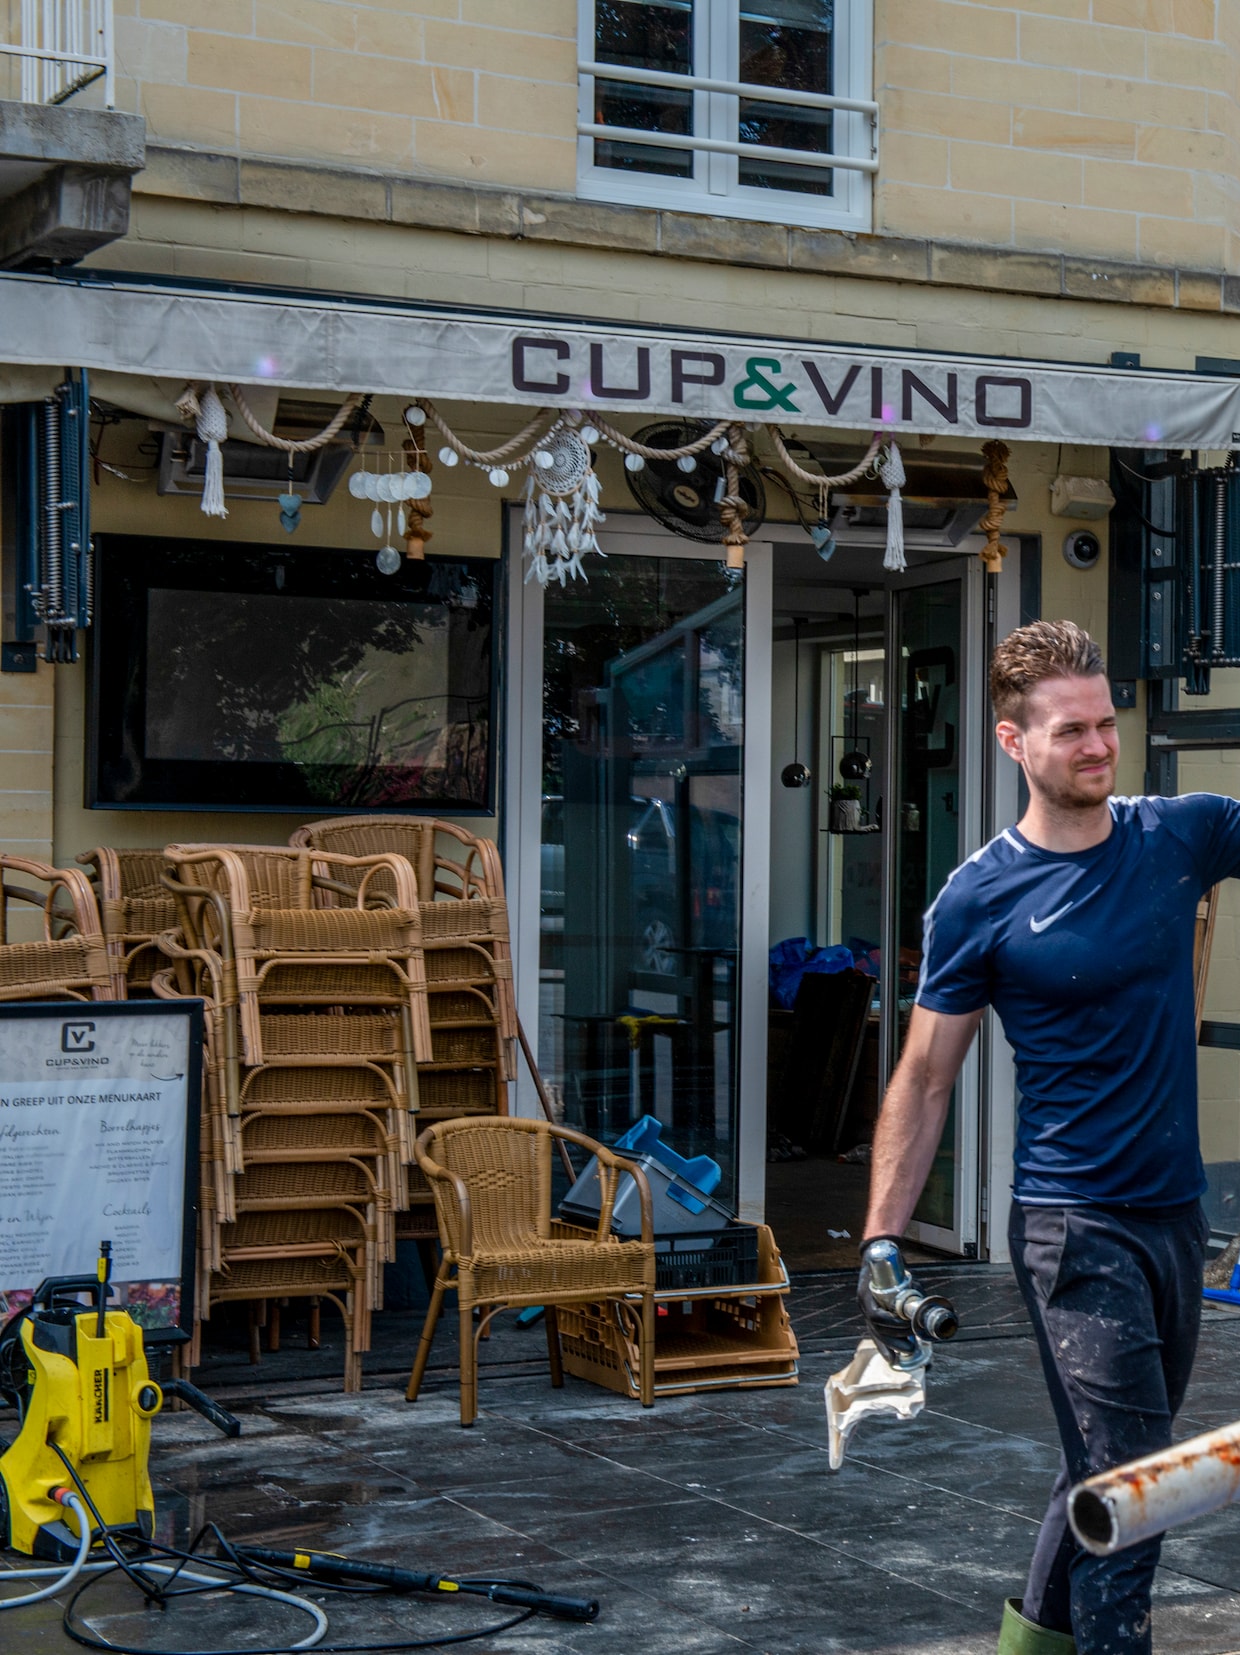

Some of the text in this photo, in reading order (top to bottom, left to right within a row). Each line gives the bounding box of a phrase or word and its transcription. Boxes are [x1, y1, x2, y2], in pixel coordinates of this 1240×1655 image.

[511, 336, 1032, 428] CUP&VINO
[45, 1056, 110, 1067] CUP&VINO
[13, 1097, 45, 1107] GREEP
[48, 1096, 64, 1105] UIT
[67, 1095, 96, 1105] ONZE
[99, 1092, 162, 1104] MENUKAART
